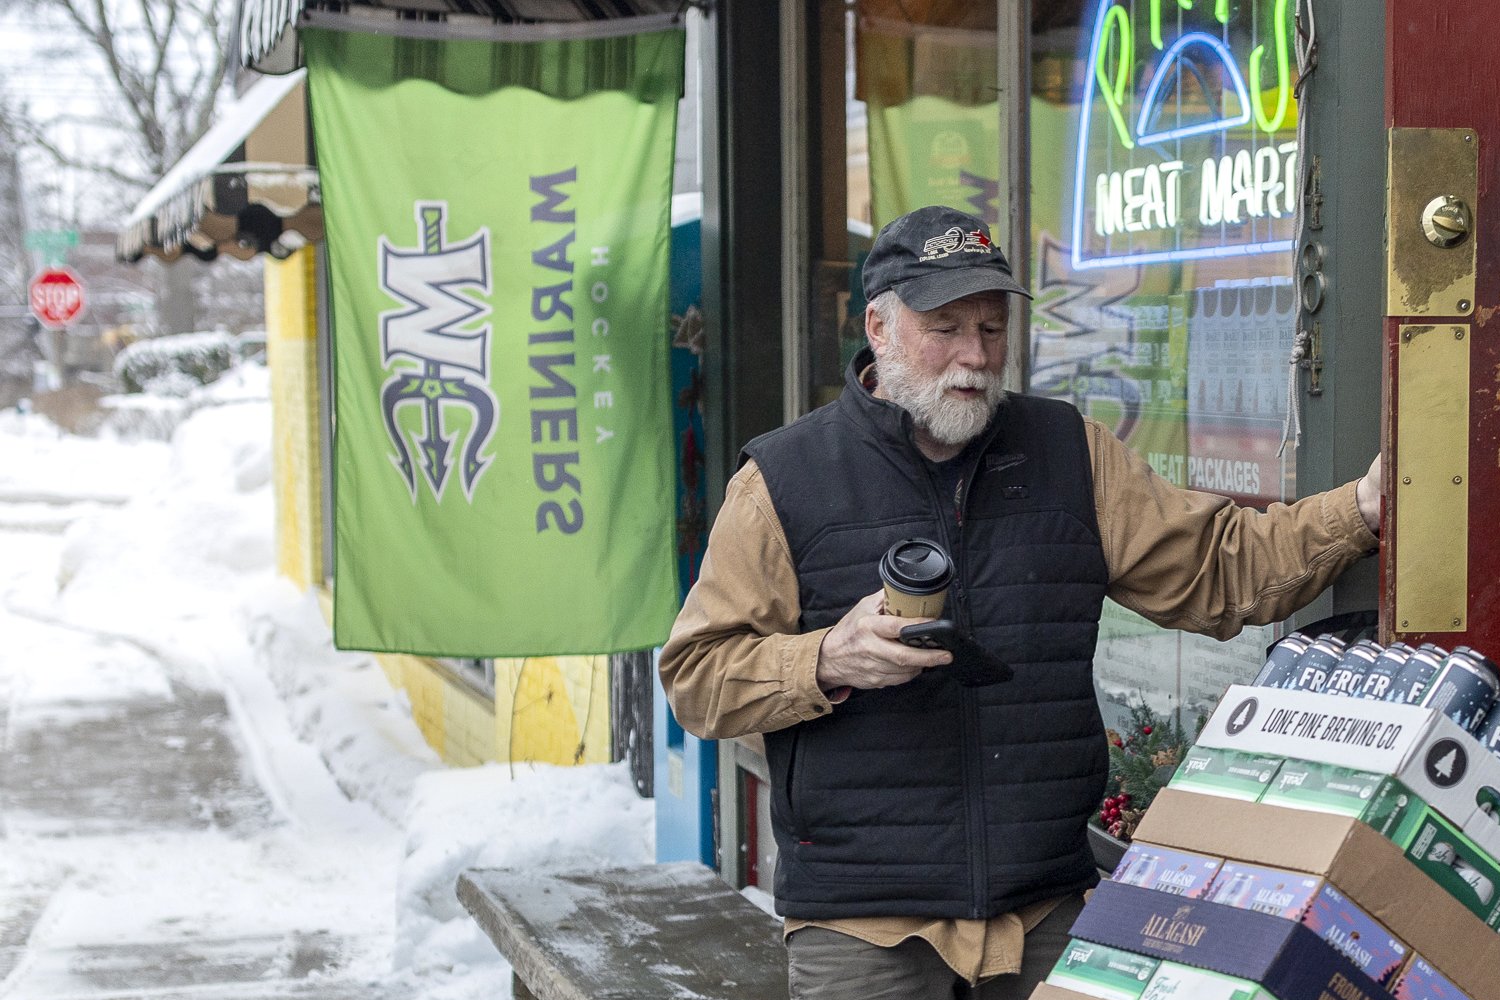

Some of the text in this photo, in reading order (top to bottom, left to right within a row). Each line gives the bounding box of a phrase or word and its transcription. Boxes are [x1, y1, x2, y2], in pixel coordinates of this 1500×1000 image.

[1095, 141, 1297, 236] MEAT MART
[32, 283, 79, 309] STOP
[1148, 452, 1261, 495] MEAT PACKAGES
[1261, 708, 1403, 751] LONE PINE BREWING CO.
[1185, 757, 1213, 777] peak
[1279, 772, 1309, 791] peak
[1158, 868, 1197, 888] ALLAGASH
[1141, 914, 1207, 947] ALLAGASH
[1066, 948, 1094, 966] peak
[1325, 925, 1373, 968] ALLAGASH
